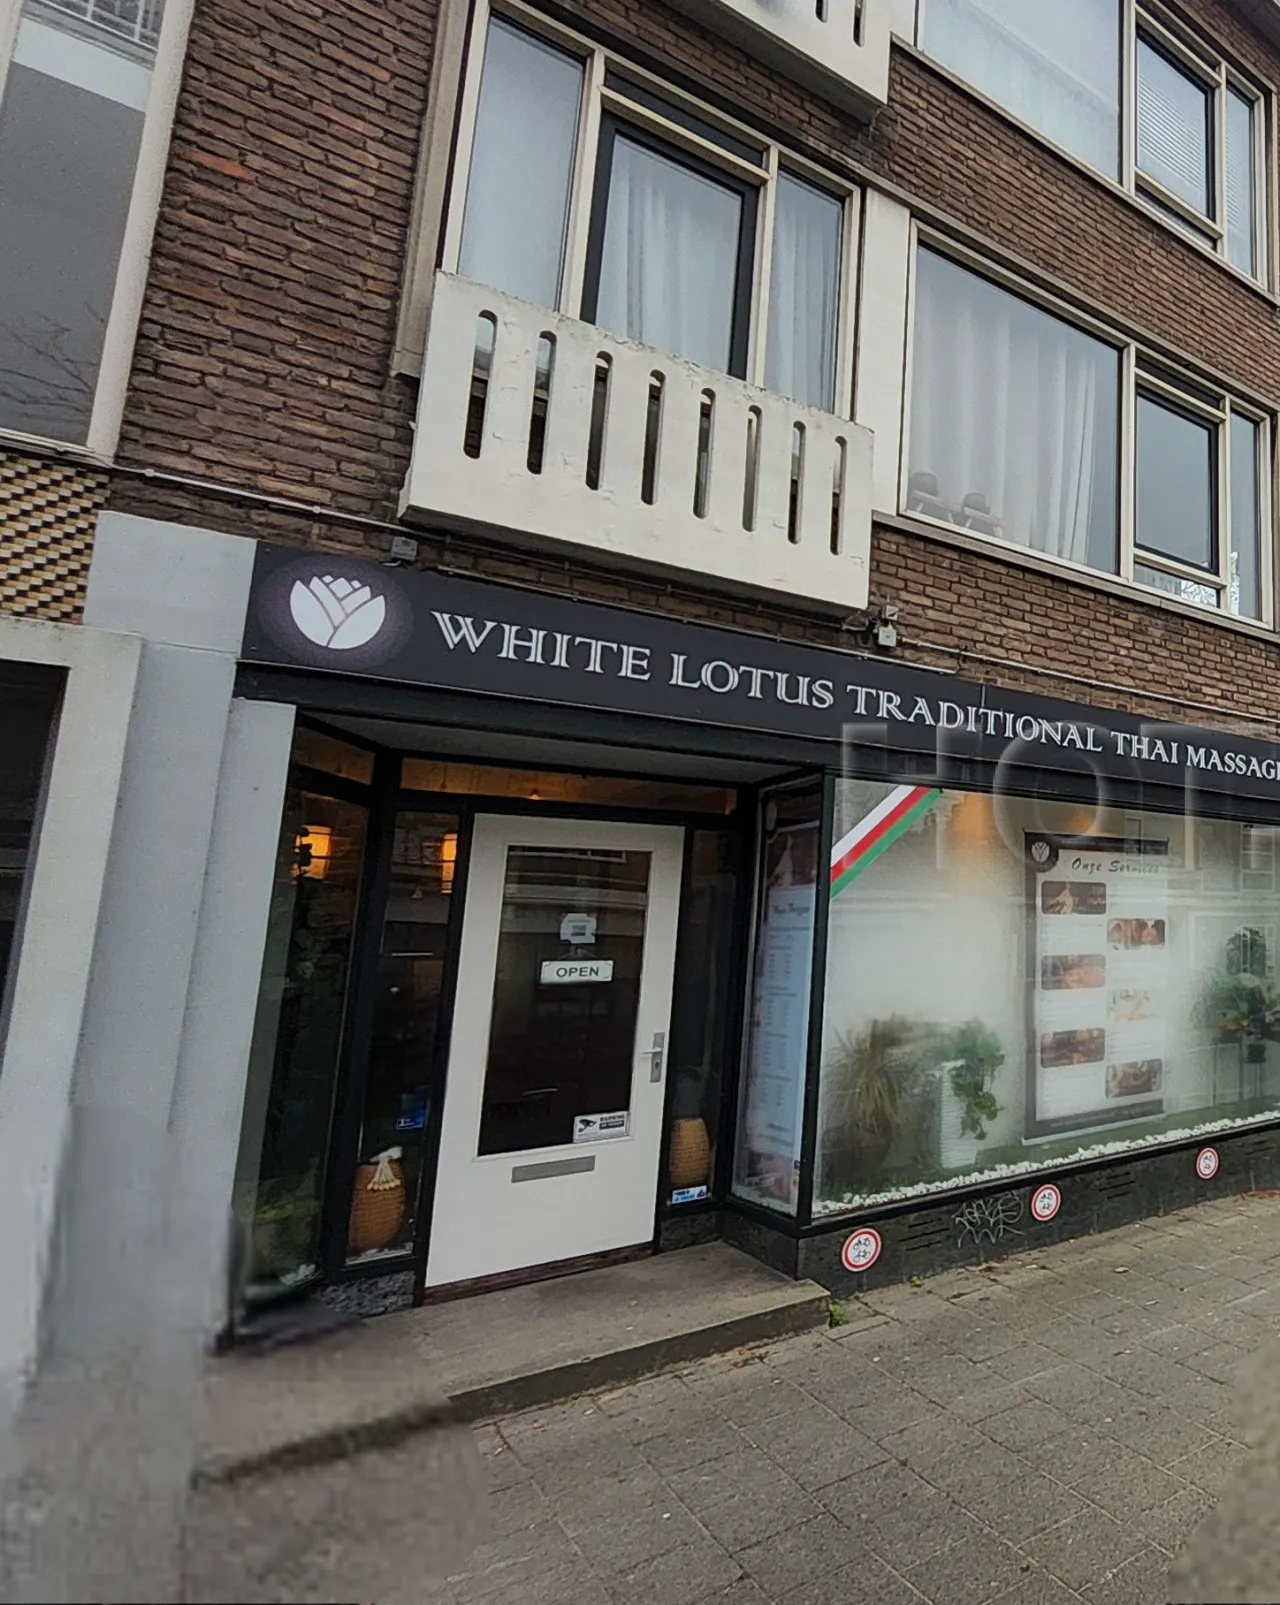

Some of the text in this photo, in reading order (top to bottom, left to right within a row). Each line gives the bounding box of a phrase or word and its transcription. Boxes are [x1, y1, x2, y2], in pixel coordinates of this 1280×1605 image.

[431, 611, 651, 682] WHITE
[669, 652, 834, 710] LOTUS
[846, 684, 1103, 754] TRADITIONAL
[1110, 730, 1179, 765] THAI
[1071, 856, 1102, 875] Onze
[555, 966, 600, 978] OPEN
